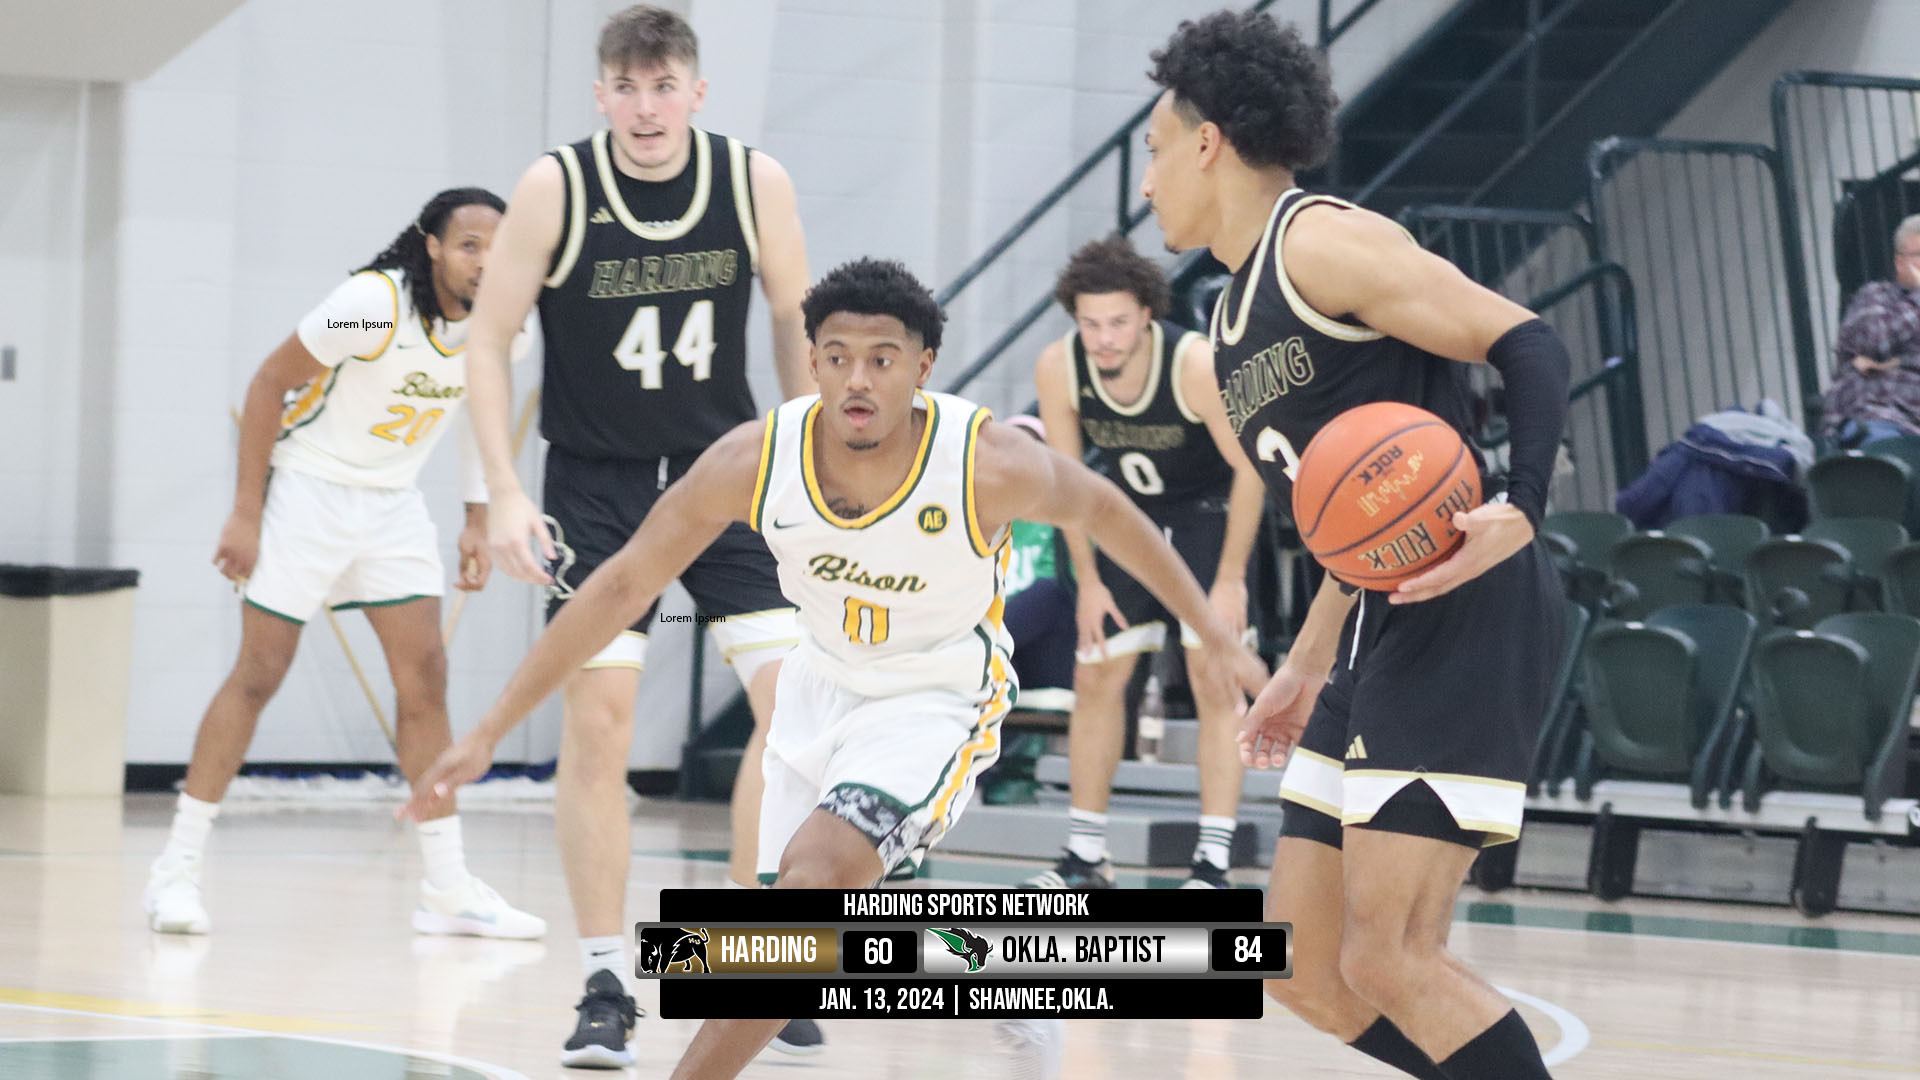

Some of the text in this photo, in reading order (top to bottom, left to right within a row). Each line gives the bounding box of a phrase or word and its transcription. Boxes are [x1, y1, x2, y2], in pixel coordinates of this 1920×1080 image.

[587, 248, 738, 298] HARDING
[612, 299, 718, 389] 44
[369, 404, 445, 446] 20
[1120, 452, 1164, 496] 0
[1357, 444, 1404, 486] ROCK
[1363, 519, 1439, 571] ROCK
[807, 554, 928, 592] Bison
[843, 596, 890, 645] 0
